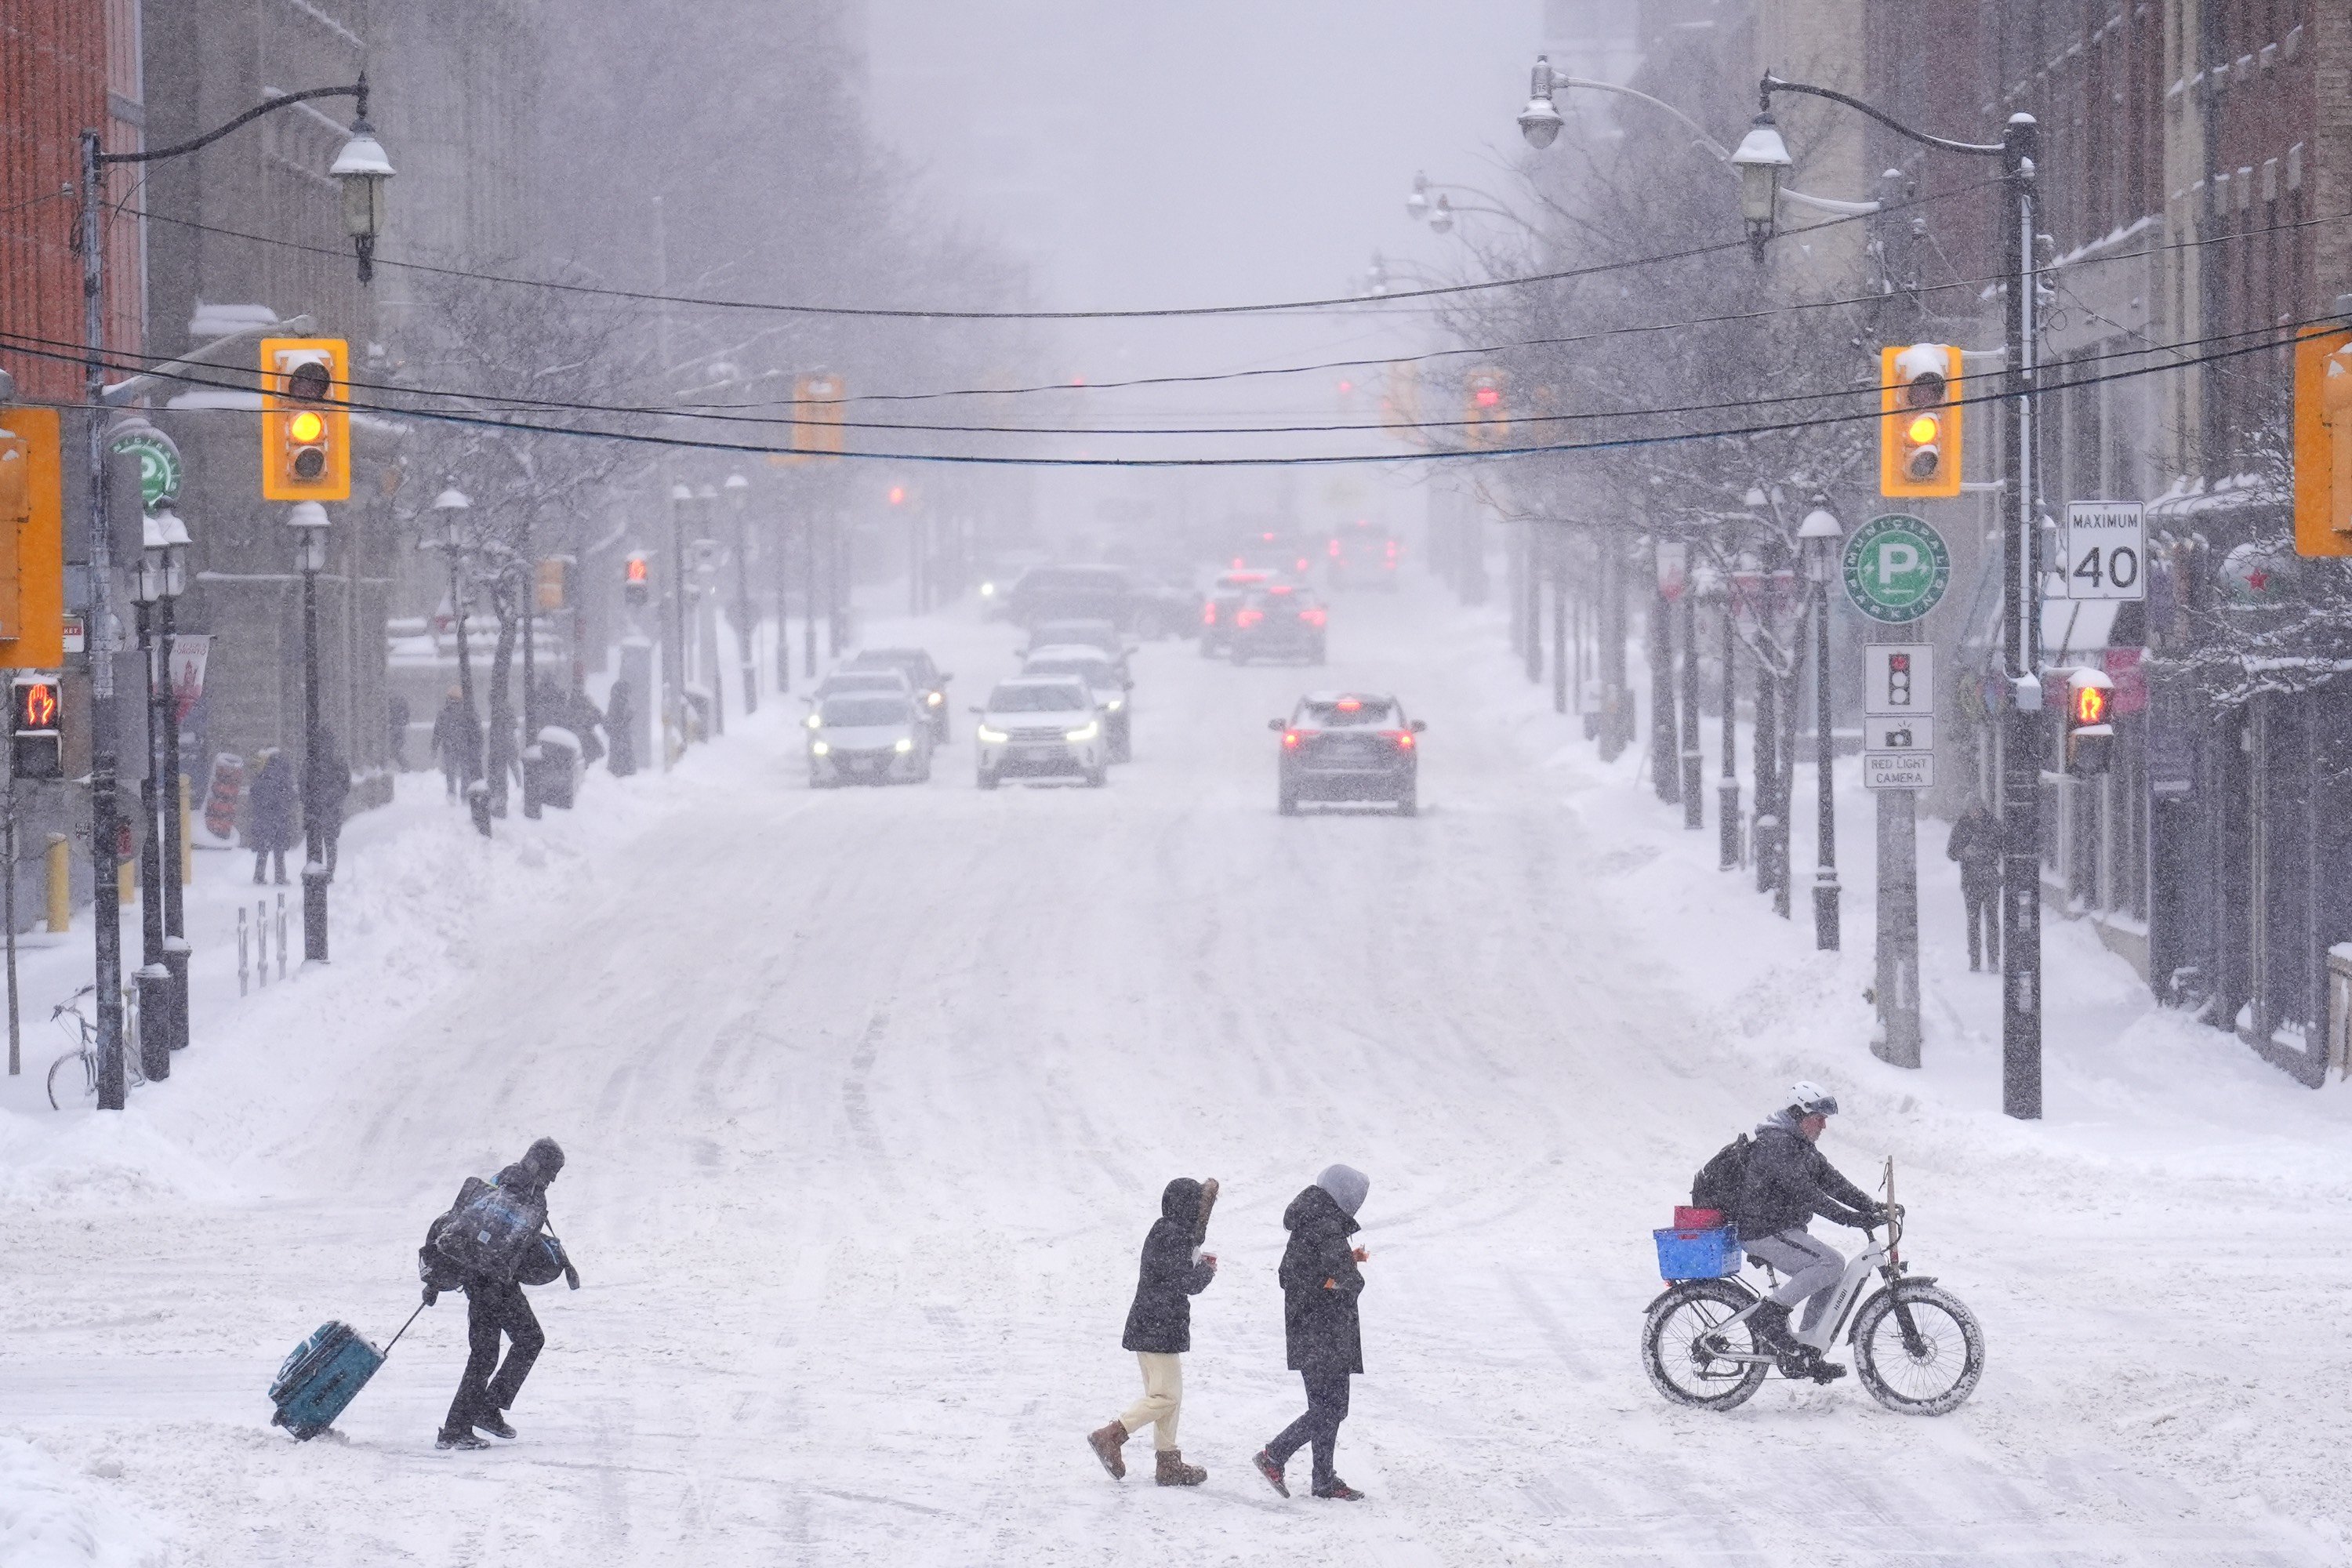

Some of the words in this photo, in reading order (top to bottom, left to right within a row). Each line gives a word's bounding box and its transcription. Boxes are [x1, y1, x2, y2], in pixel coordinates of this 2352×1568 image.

[1847, 519, 1945, 564] MUNICIPAL
[2073, 514, 2138, 529] MAXIMUM
[1878, 543, 1919, 584] P
[2072, 546, 2138, 588] 40
[1849, 578, 1944, 618] PARKING
[1871, 759, 1893, 769] RED
[1896, 758, 1926, 769] LIGHT
[1876, 773, 1923, 783] CAMERA
